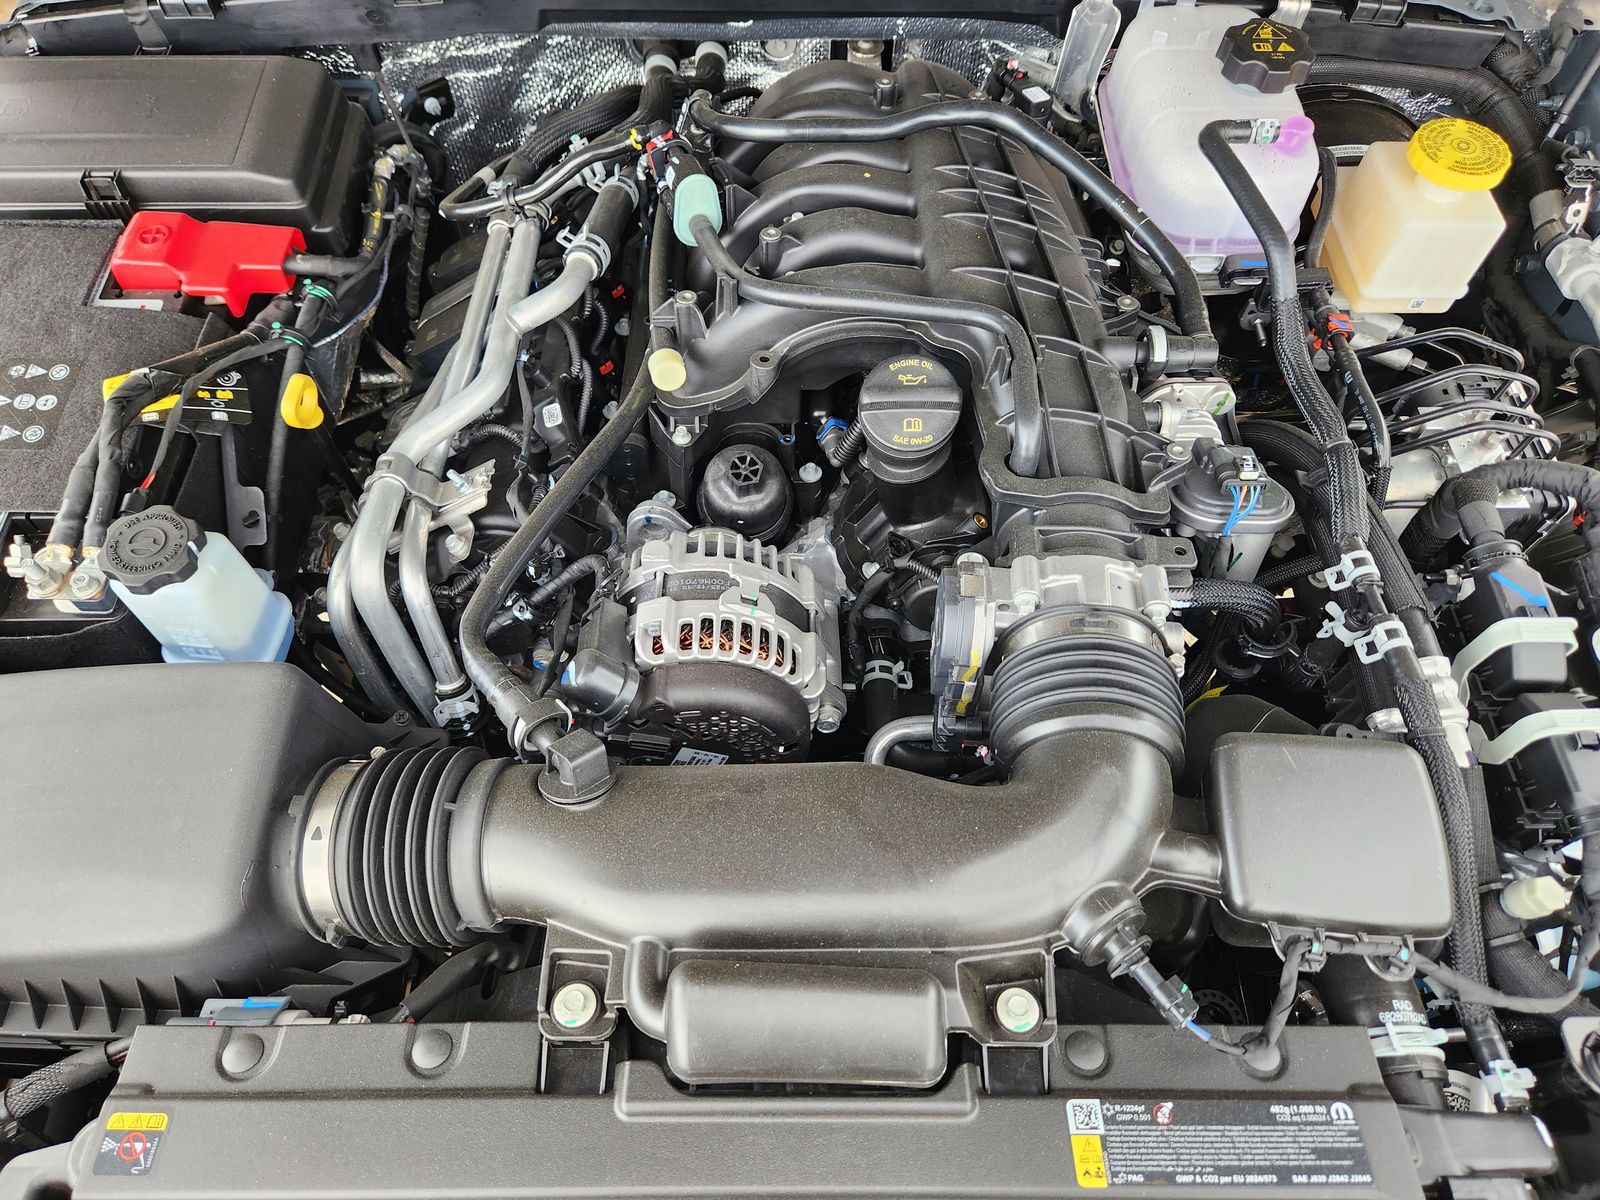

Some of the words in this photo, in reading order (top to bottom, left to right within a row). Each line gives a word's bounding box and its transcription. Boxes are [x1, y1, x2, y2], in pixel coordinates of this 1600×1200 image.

[889, 359, 920, 371] ENGINE
[921, 360, 934, 370] OIL
[893, 434, 909, 444] SAE
[910, 434, 933, 444] 0W-20
[124, 517, 141, 529] USE
[142, 513, 183, 531] APPROVED
[1392, 1000, 1412, 1010] RAD
[1128, 1174, 1144, 1182] PAG
[1176, 1175, 1194, 1183] GWP
[1203, 1175, 1219, 1183] CO2
[1220, 1177, 1232, 1185] per
[1232, 1174, 1244, 1183] EU
[1292, 1174, 1308, 1183] SAE
